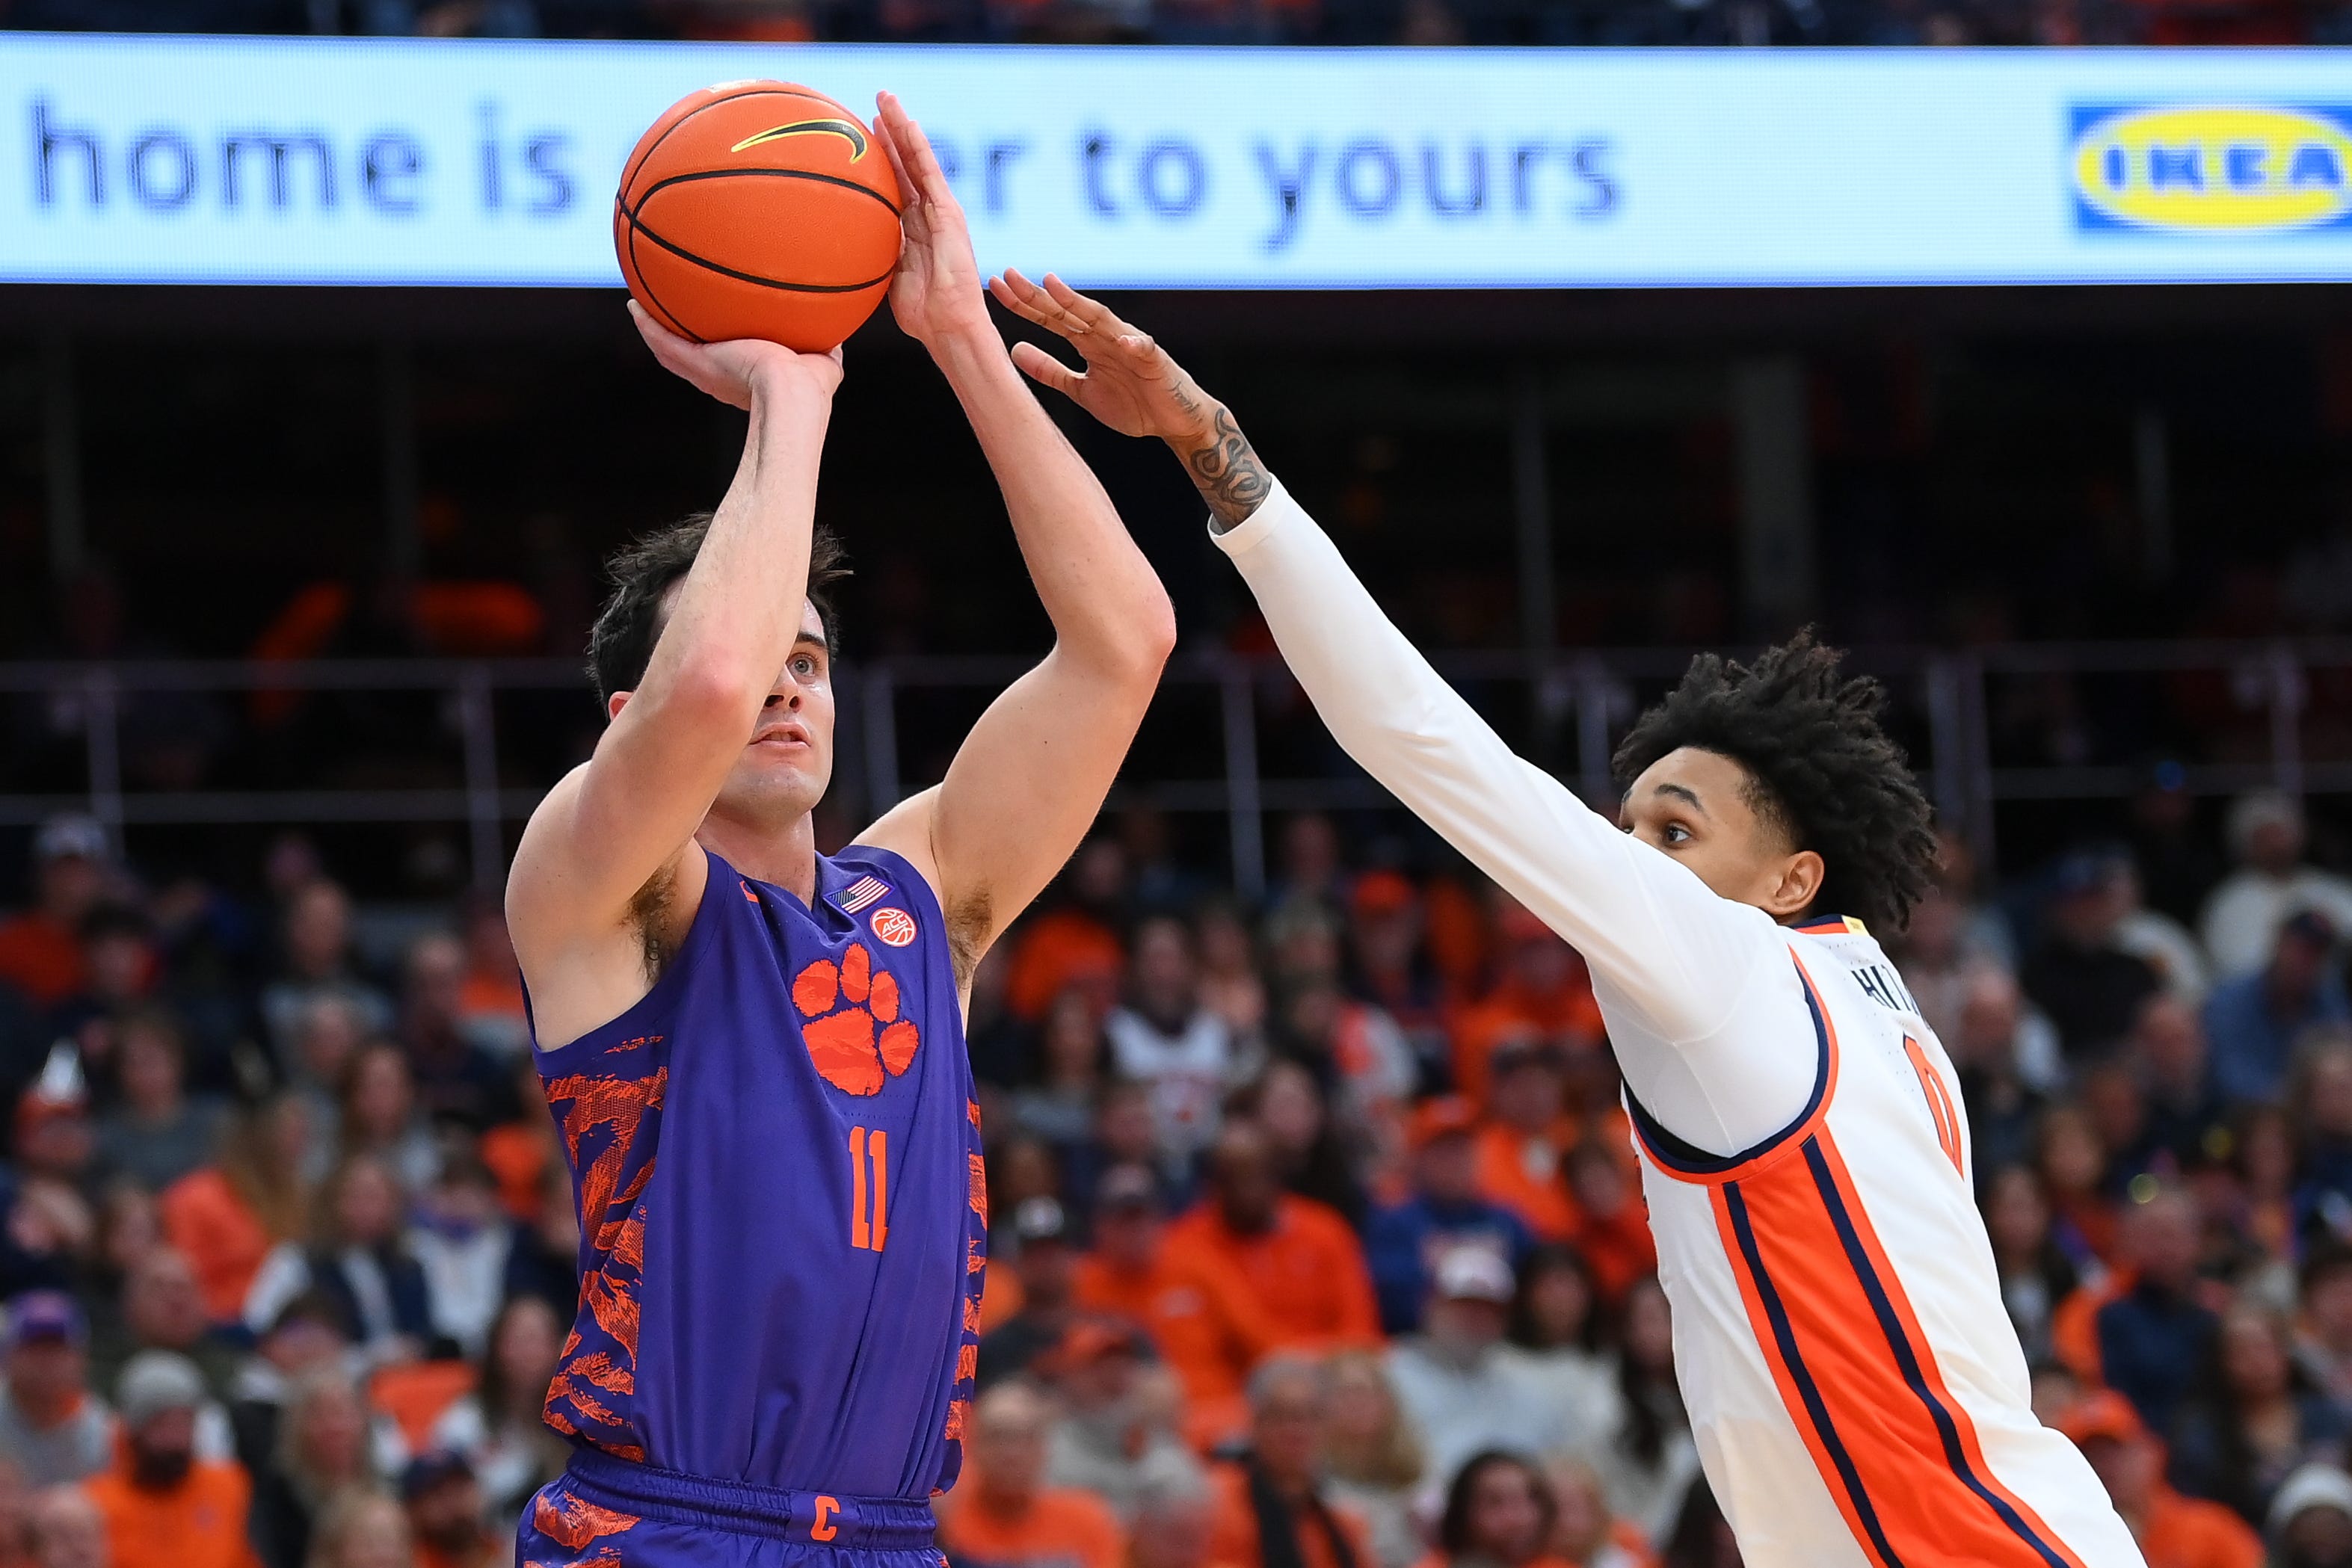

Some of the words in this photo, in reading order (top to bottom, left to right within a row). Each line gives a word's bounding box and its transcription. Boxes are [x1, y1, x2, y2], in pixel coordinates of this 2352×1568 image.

[30, 93, 425, 214] home
[476, 96, 577, 215] is
[1080, 123, 1208, 219] to
[1252, 135, 1625, 254] yours
[2105, 142, 2343, 192] IKEA
[882, 913, 907, 934] ACC
[849, 1126, 888, 1252] 11
[810, 1496, 840, 1541] C
